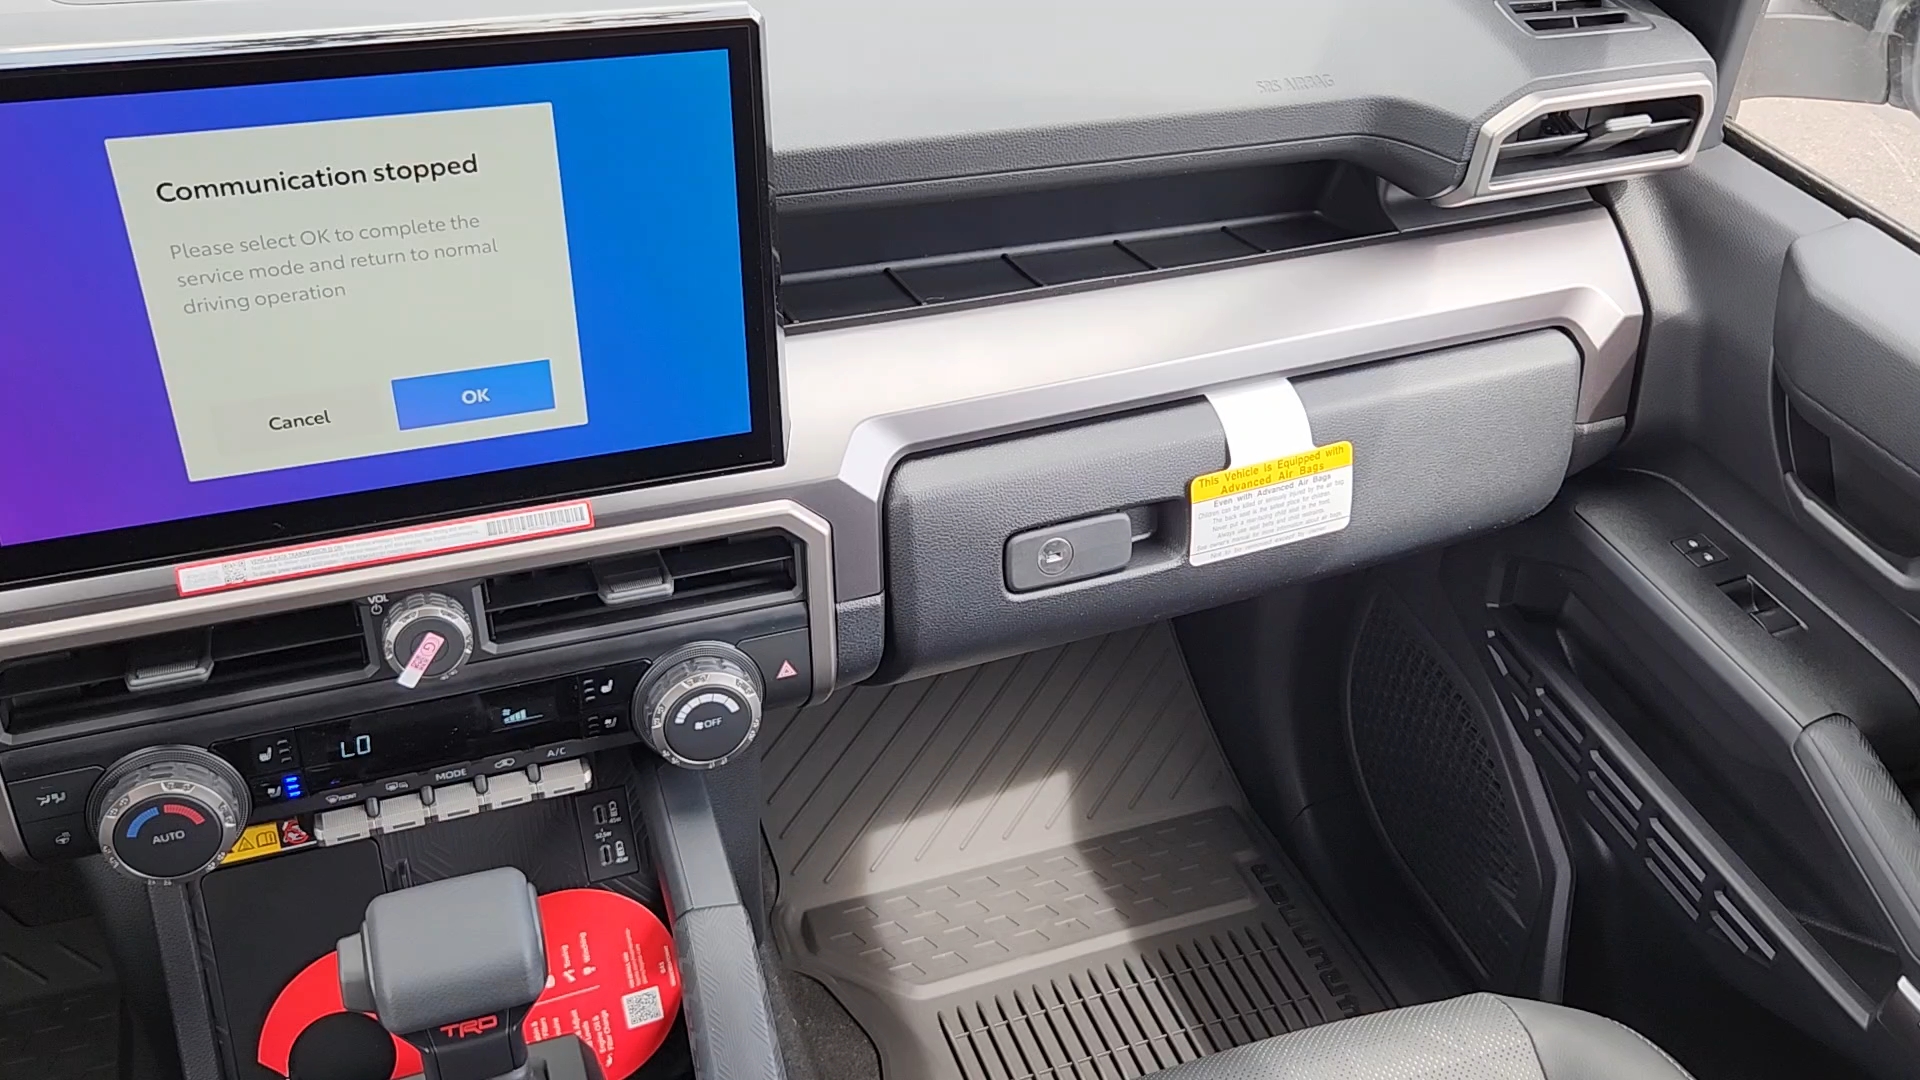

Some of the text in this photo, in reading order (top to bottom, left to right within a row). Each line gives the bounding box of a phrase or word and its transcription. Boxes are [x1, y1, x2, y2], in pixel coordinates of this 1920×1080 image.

[1256, 79, 1281, 94] SRS
[156, 153, 478, 202] Communication stopped
[170, 214, 480, 260] Please select OK to complete the
[177, 238, 499, 288] service mode and return to normal
[183, 284, 346, 315] driving operation
[461, 388, 491, 405] OK
[268, 409, 332, 431] Cancel
[1198, 475, 1218, 488] This
[1224, 465, 1258, 482] Vehicle
[1278, 450, 1320, 469] Equipped
[1326, 444, 1344, 457] with
[1220, 461, 1324, 494] Advanced Air Bags
[1214, 473, 1330, 507] Even with Advanced Air Bags
[367, 594, 389, 604] VOL
[704, 717, 722, 728] OFF
[341, 735, 371, 758] LO
[547, 746, 567, 758] A/C
[435, 768, 467, 781] MODE
[152, 830, 186, 845] AUTO
[440, 1015, 497, 1038] TRD
